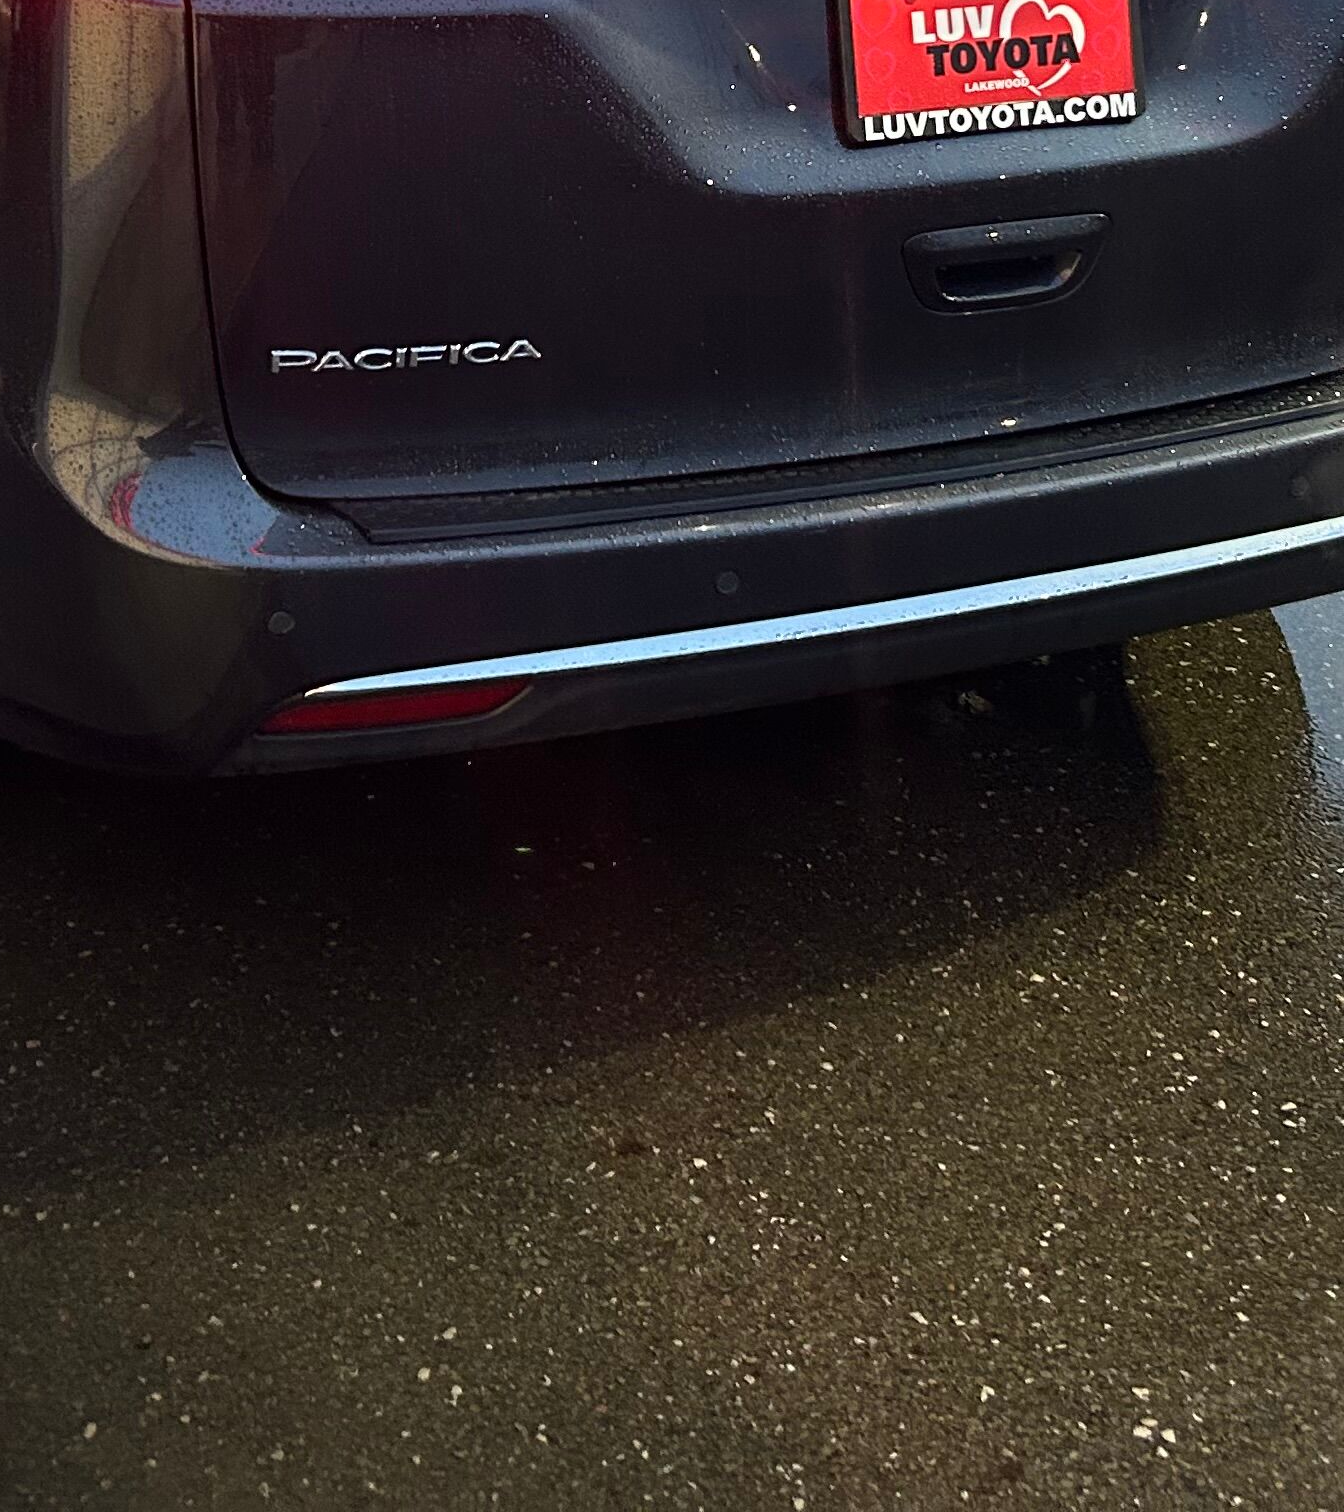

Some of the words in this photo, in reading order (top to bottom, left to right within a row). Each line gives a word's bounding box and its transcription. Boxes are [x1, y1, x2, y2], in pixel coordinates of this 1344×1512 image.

[911, 4, 994, 44] LUV
[926, 32, 1081, 77] TOYOTA
[964, 76, 1030, 94] LAKEWOOD
[863, 91, 1137, 142] LUVTOYOTA.COM
[270, 338, 543, 374] PACIFICA
